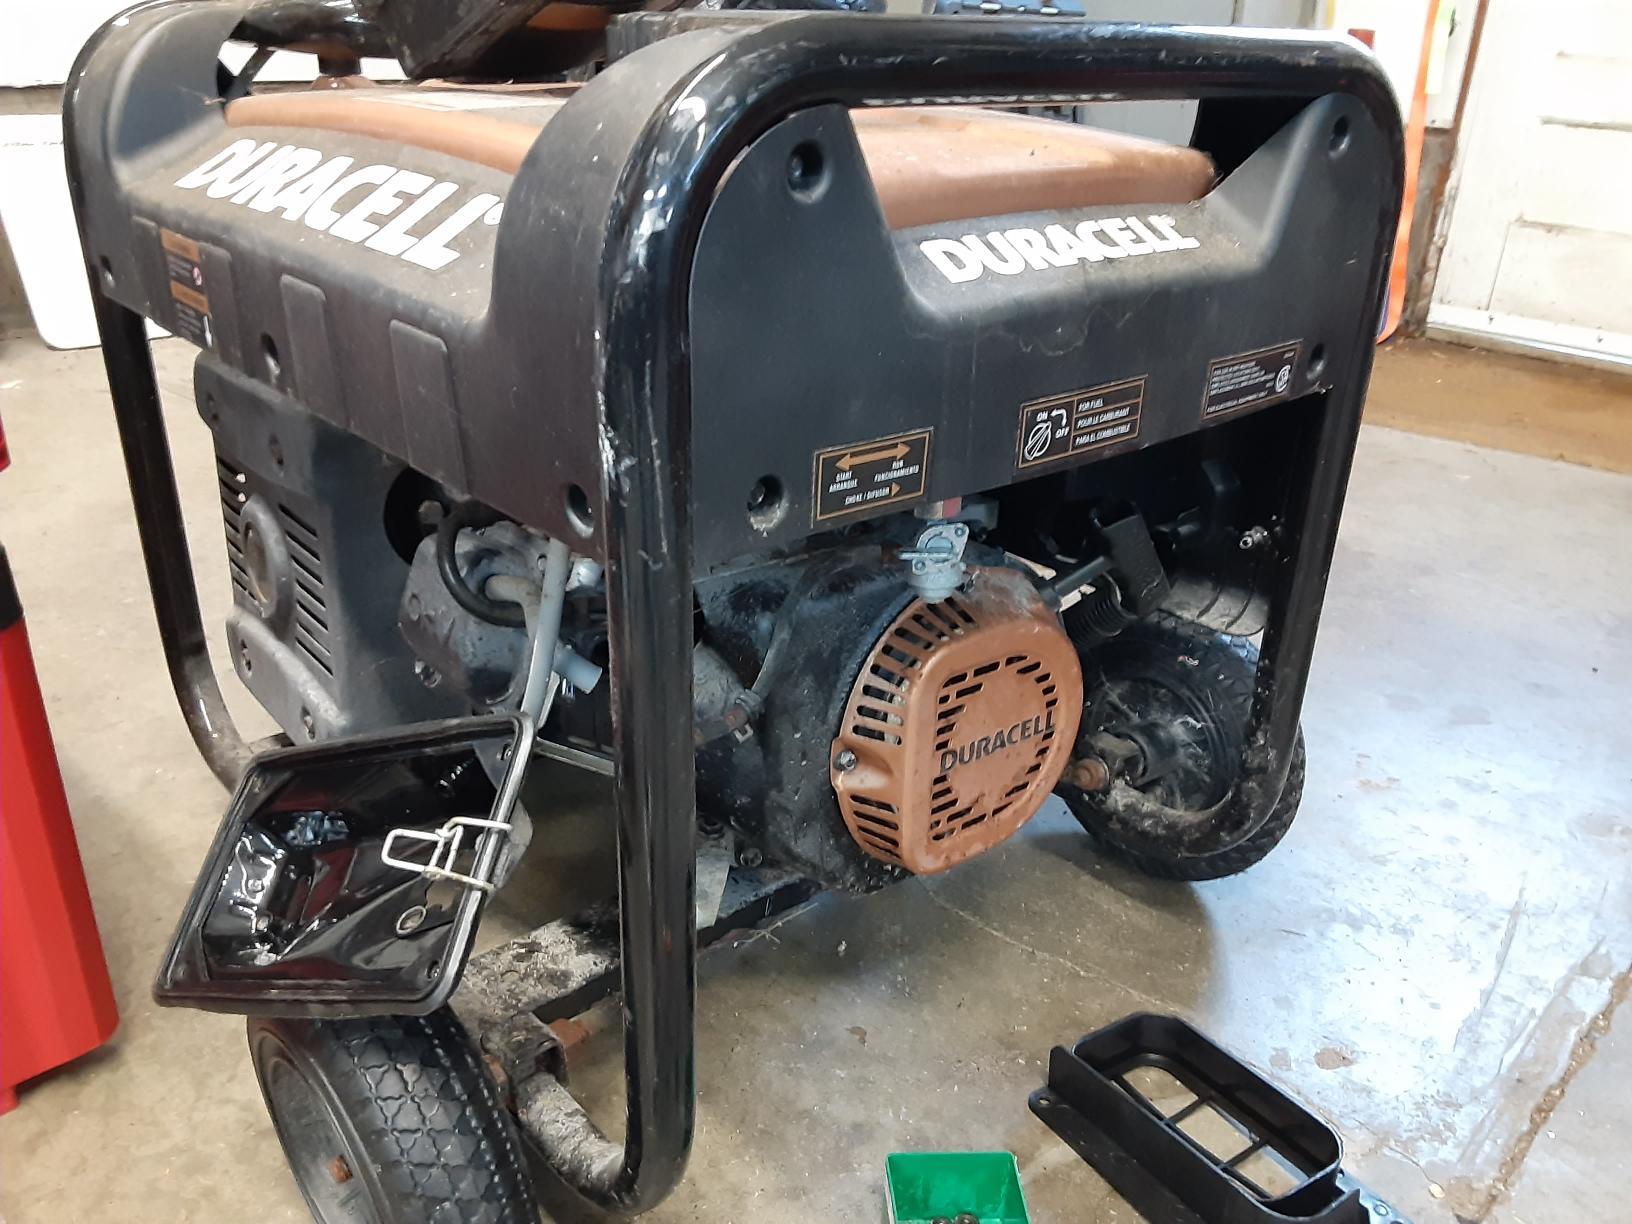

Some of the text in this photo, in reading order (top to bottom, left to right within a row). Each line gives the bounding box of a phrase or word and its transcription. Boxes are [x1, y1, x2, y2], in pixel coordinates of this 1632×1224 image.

[173, 138, 501, 271] DURACELL
[919, 214, 1201, 284] DURACELL
[1078, 398, 1104, 412] FOR FUEL
[1036, 411, 1048, 421] ON
[1055, 426, 1070, 439] OFF
[835, 470, 853, 483] START
[940, 709, 1056, 773] DURACELL
